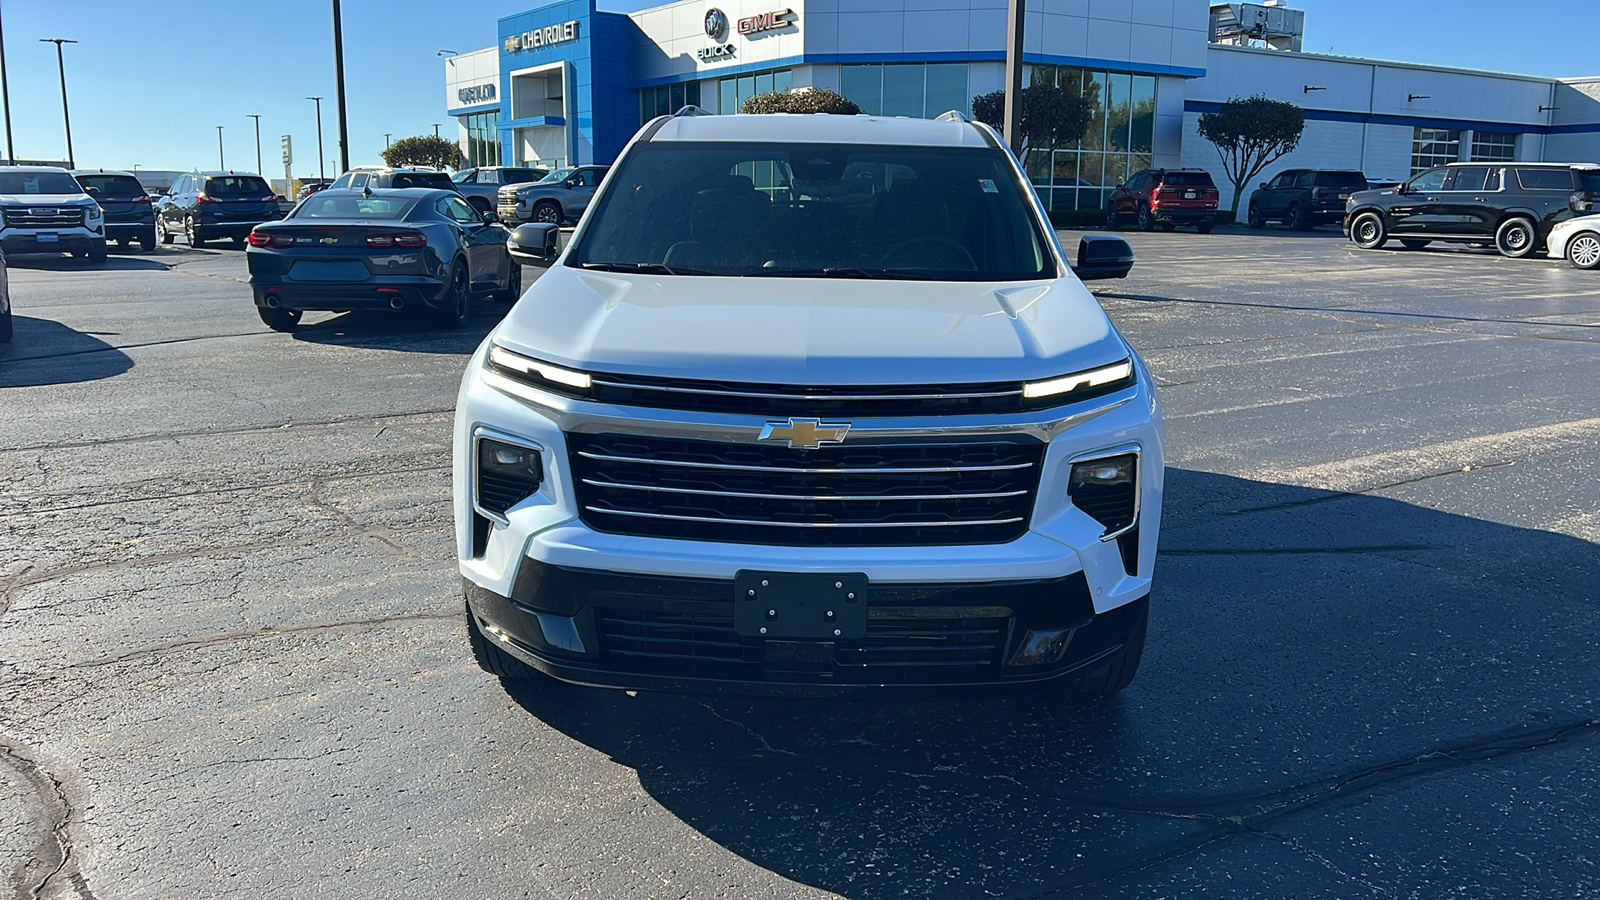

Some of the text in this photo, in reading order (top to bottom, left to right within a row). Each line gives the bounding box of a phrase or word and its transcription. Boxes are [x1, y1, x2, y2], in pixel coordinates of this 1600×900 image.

[522, 20, 578, 50] CHEVROLET
[737, 8, 791, 35] GMC
[697, 44, 731, 59] BUICK
